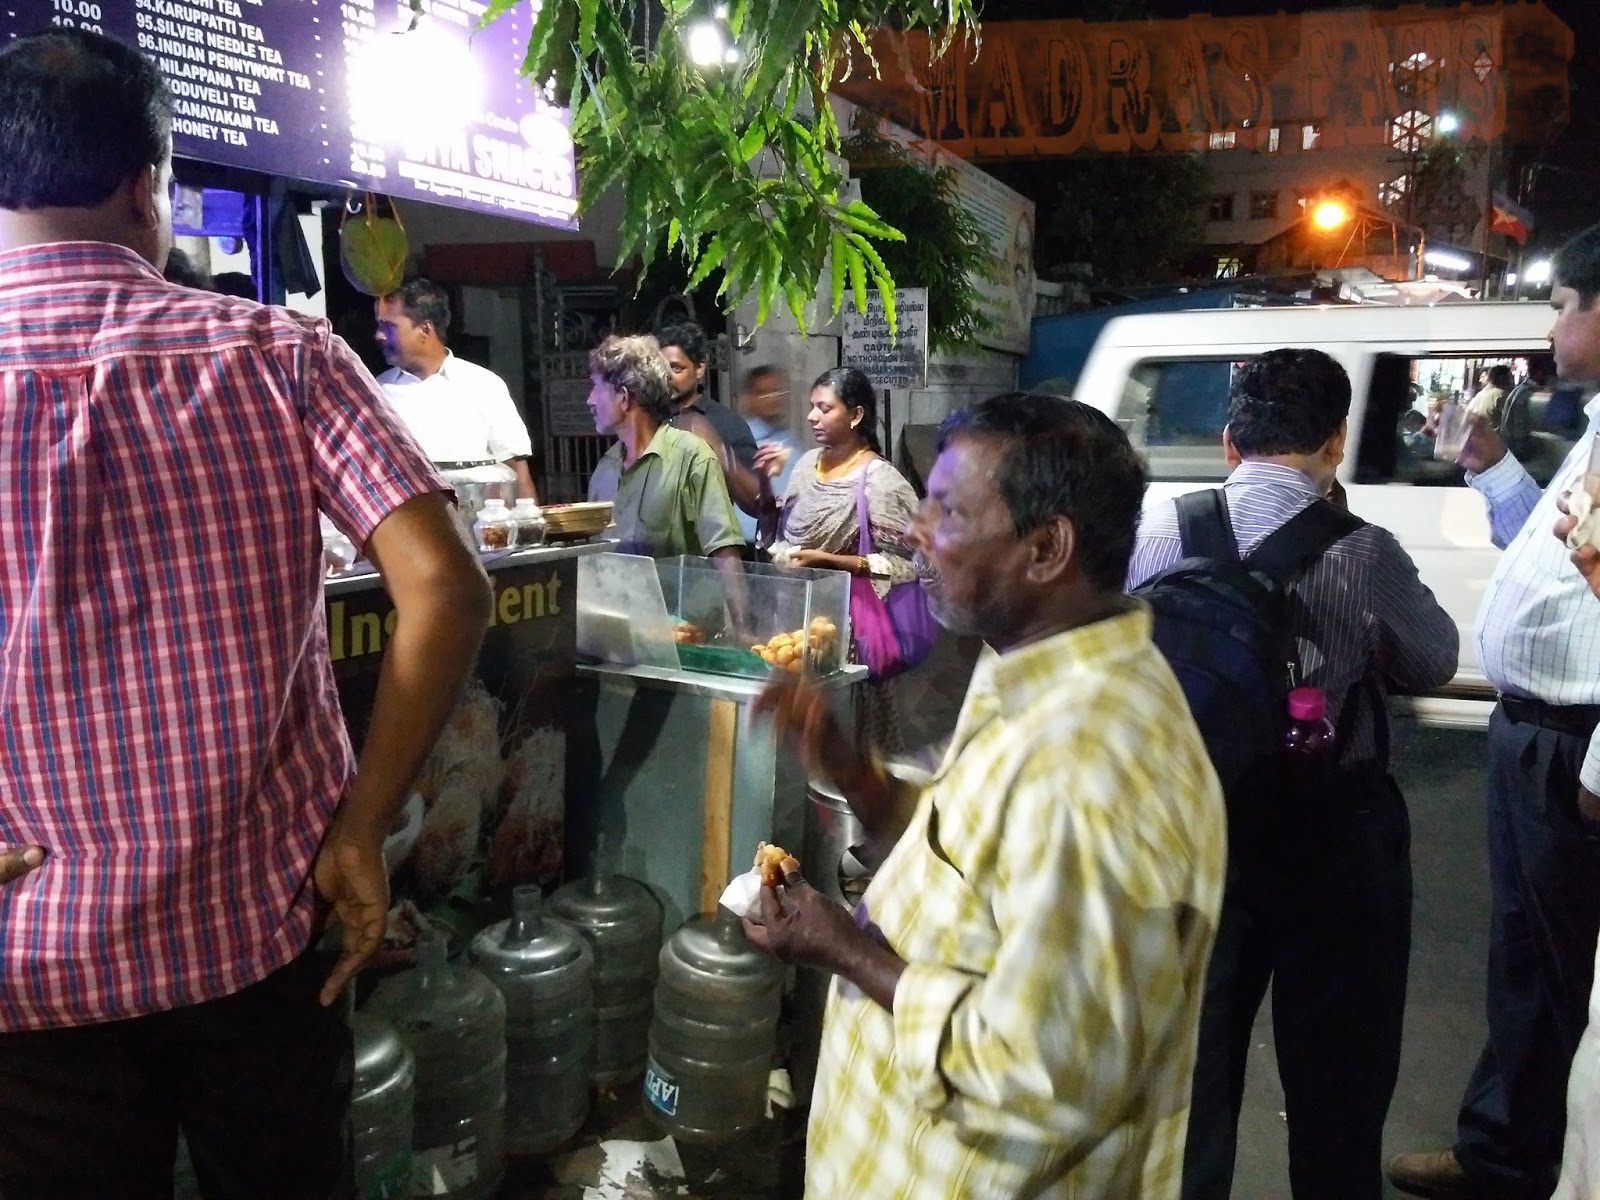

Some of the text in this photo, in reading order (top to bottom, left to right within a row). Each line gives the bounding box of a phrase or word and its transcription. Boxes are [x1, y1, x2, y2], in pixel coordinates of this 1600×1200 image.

[216, 0, 242, 18] TEA
[52, 15, 103, 35] 1000
[239, 22, 265, 42] TEA
[136, 12, 283, 65] 95.SILVER NEEDLE TEA
[137, 32, 312, 90] 96.INDIAN PENNYWORT TEA
[147, 54, 262, 96] NILAPPANA TEA
[230, 93, 257, 113] TEA
[170, 117, 248, 147] .HONEY TEA
[254, 117, 280, 136] TEA
[864, 344, 903, 352] CAUTIN
